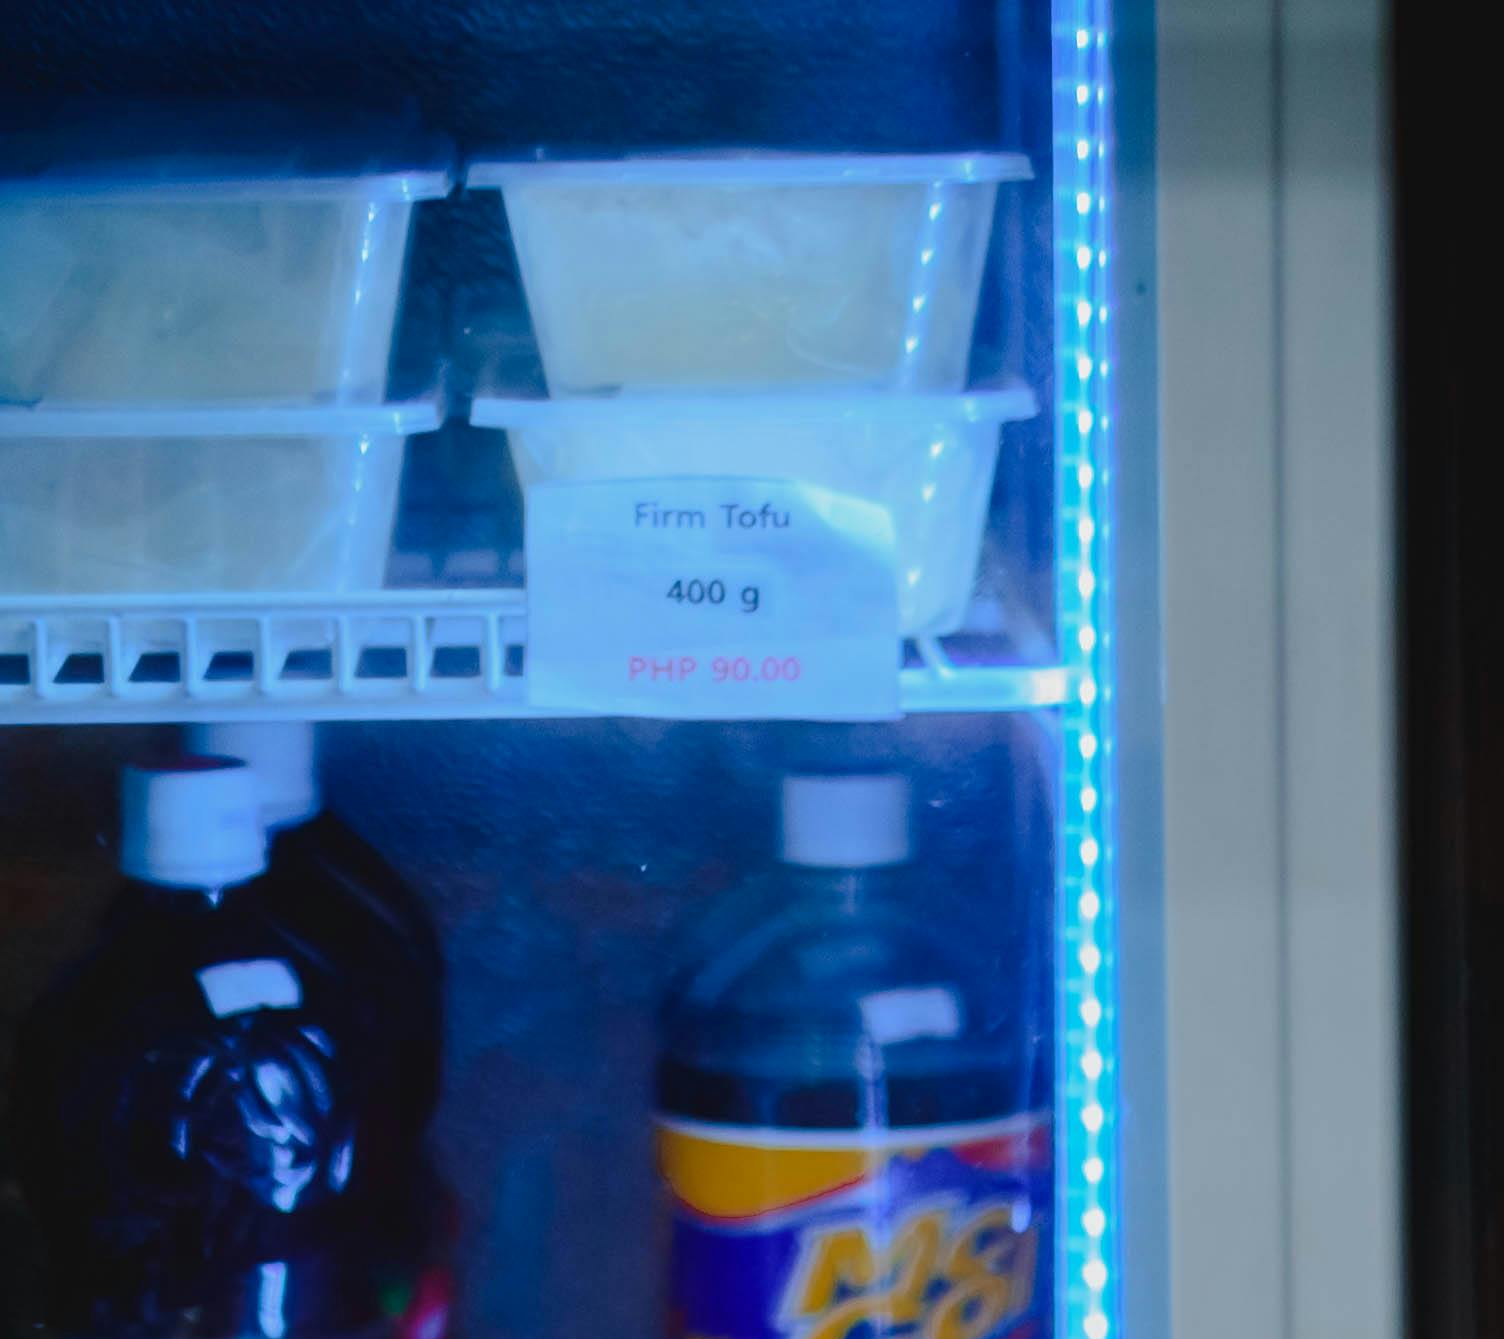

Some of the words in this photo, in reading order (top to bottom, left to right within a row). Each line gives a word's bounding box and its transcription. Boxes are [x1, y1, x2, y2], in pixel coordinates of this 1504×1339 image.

[633, 502, 706, 529] Firm
[720, 502, 791, 529] Tofu
[666, 579, 726, 605] 400
[740, 585, 761, 613] g
[627, 655, 698, 682] PHP
[710, 655, 803, 683] 90.00
